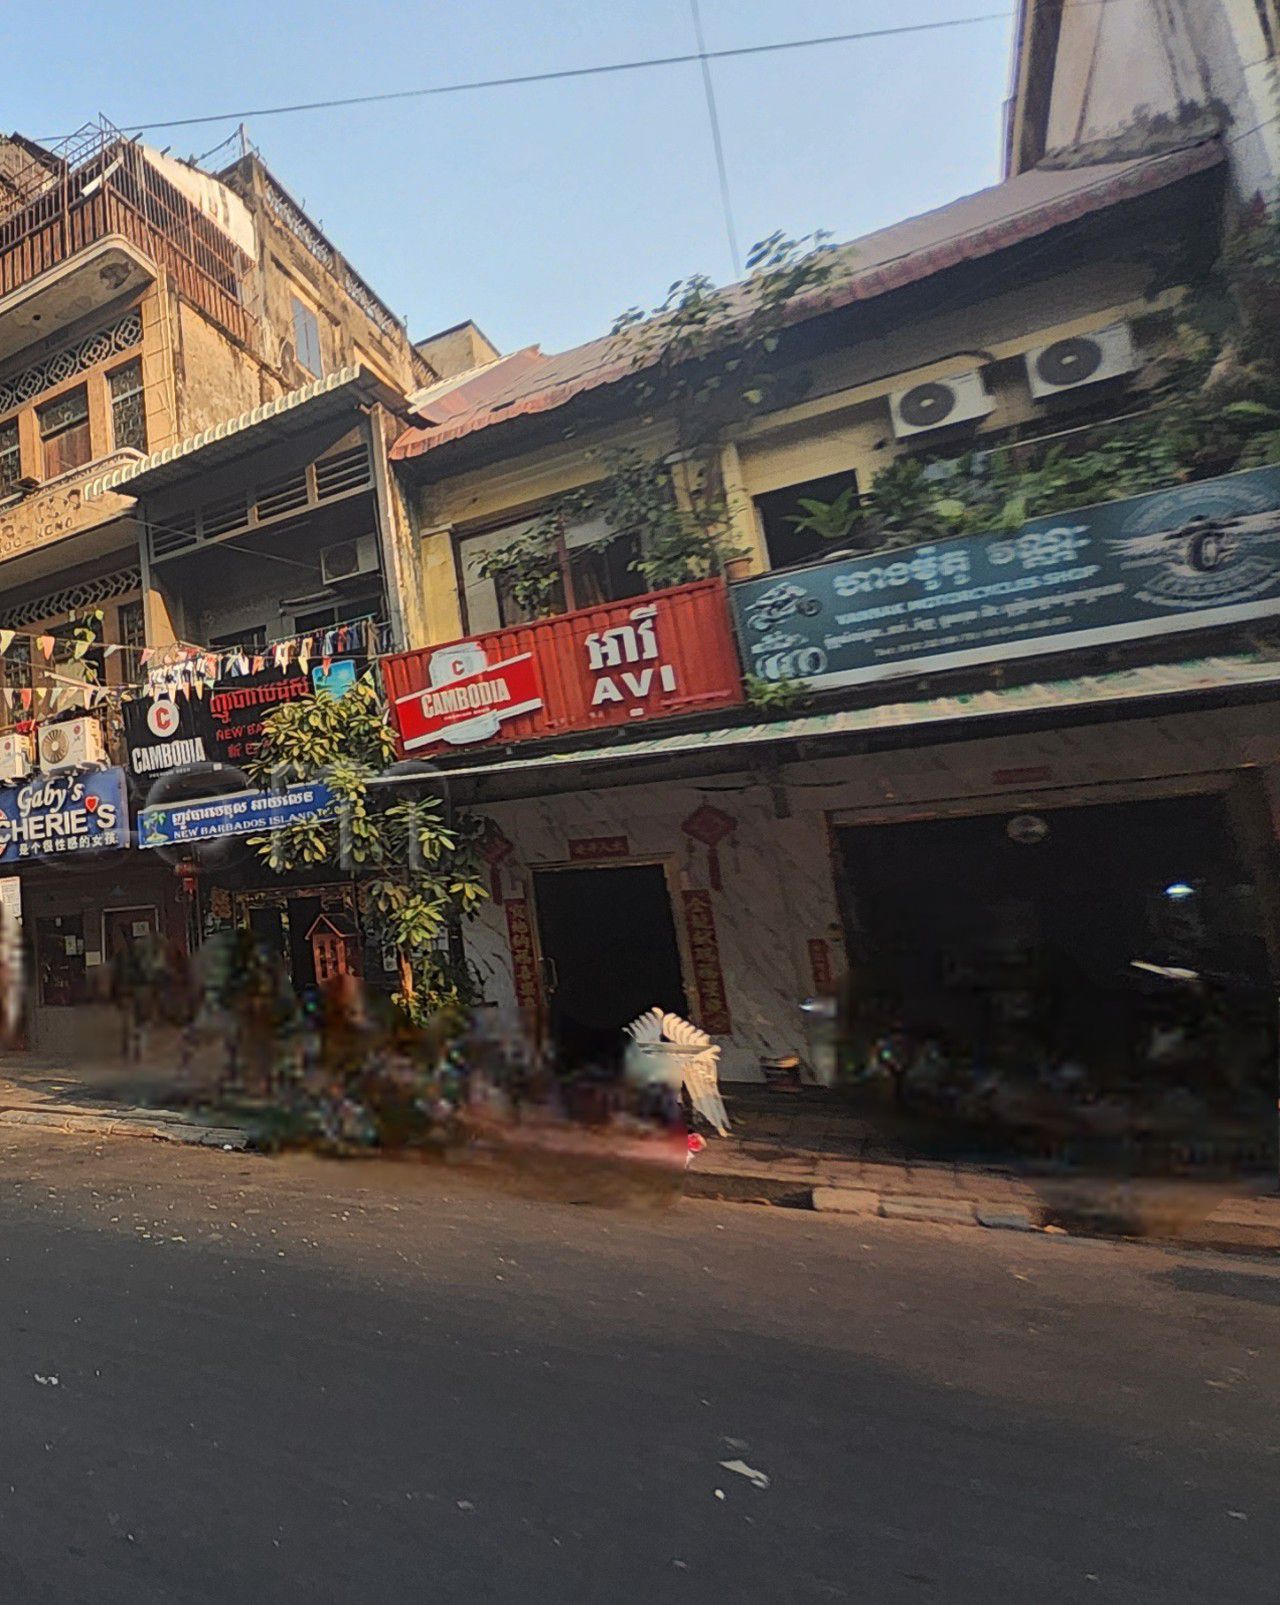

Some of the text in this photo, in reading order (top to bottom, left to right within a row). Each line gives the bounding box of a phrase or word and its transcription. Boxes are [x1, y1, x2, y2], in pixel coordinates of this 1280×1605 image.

[584, 603, 658, 670] អាវី
[421, 678, 511, 718] CAMBODIA
[591, 664, 677, 705] AVI
[155, 707, 171, 730] C
[216, 725, 244, 741] NEW
[132, 737, 206, 774] CAMBODIA
[17, 776, 86, 818] Gaby's
[173, 827, 200, 839] NEW
[201, 818, 267, 836] BARBADOS
